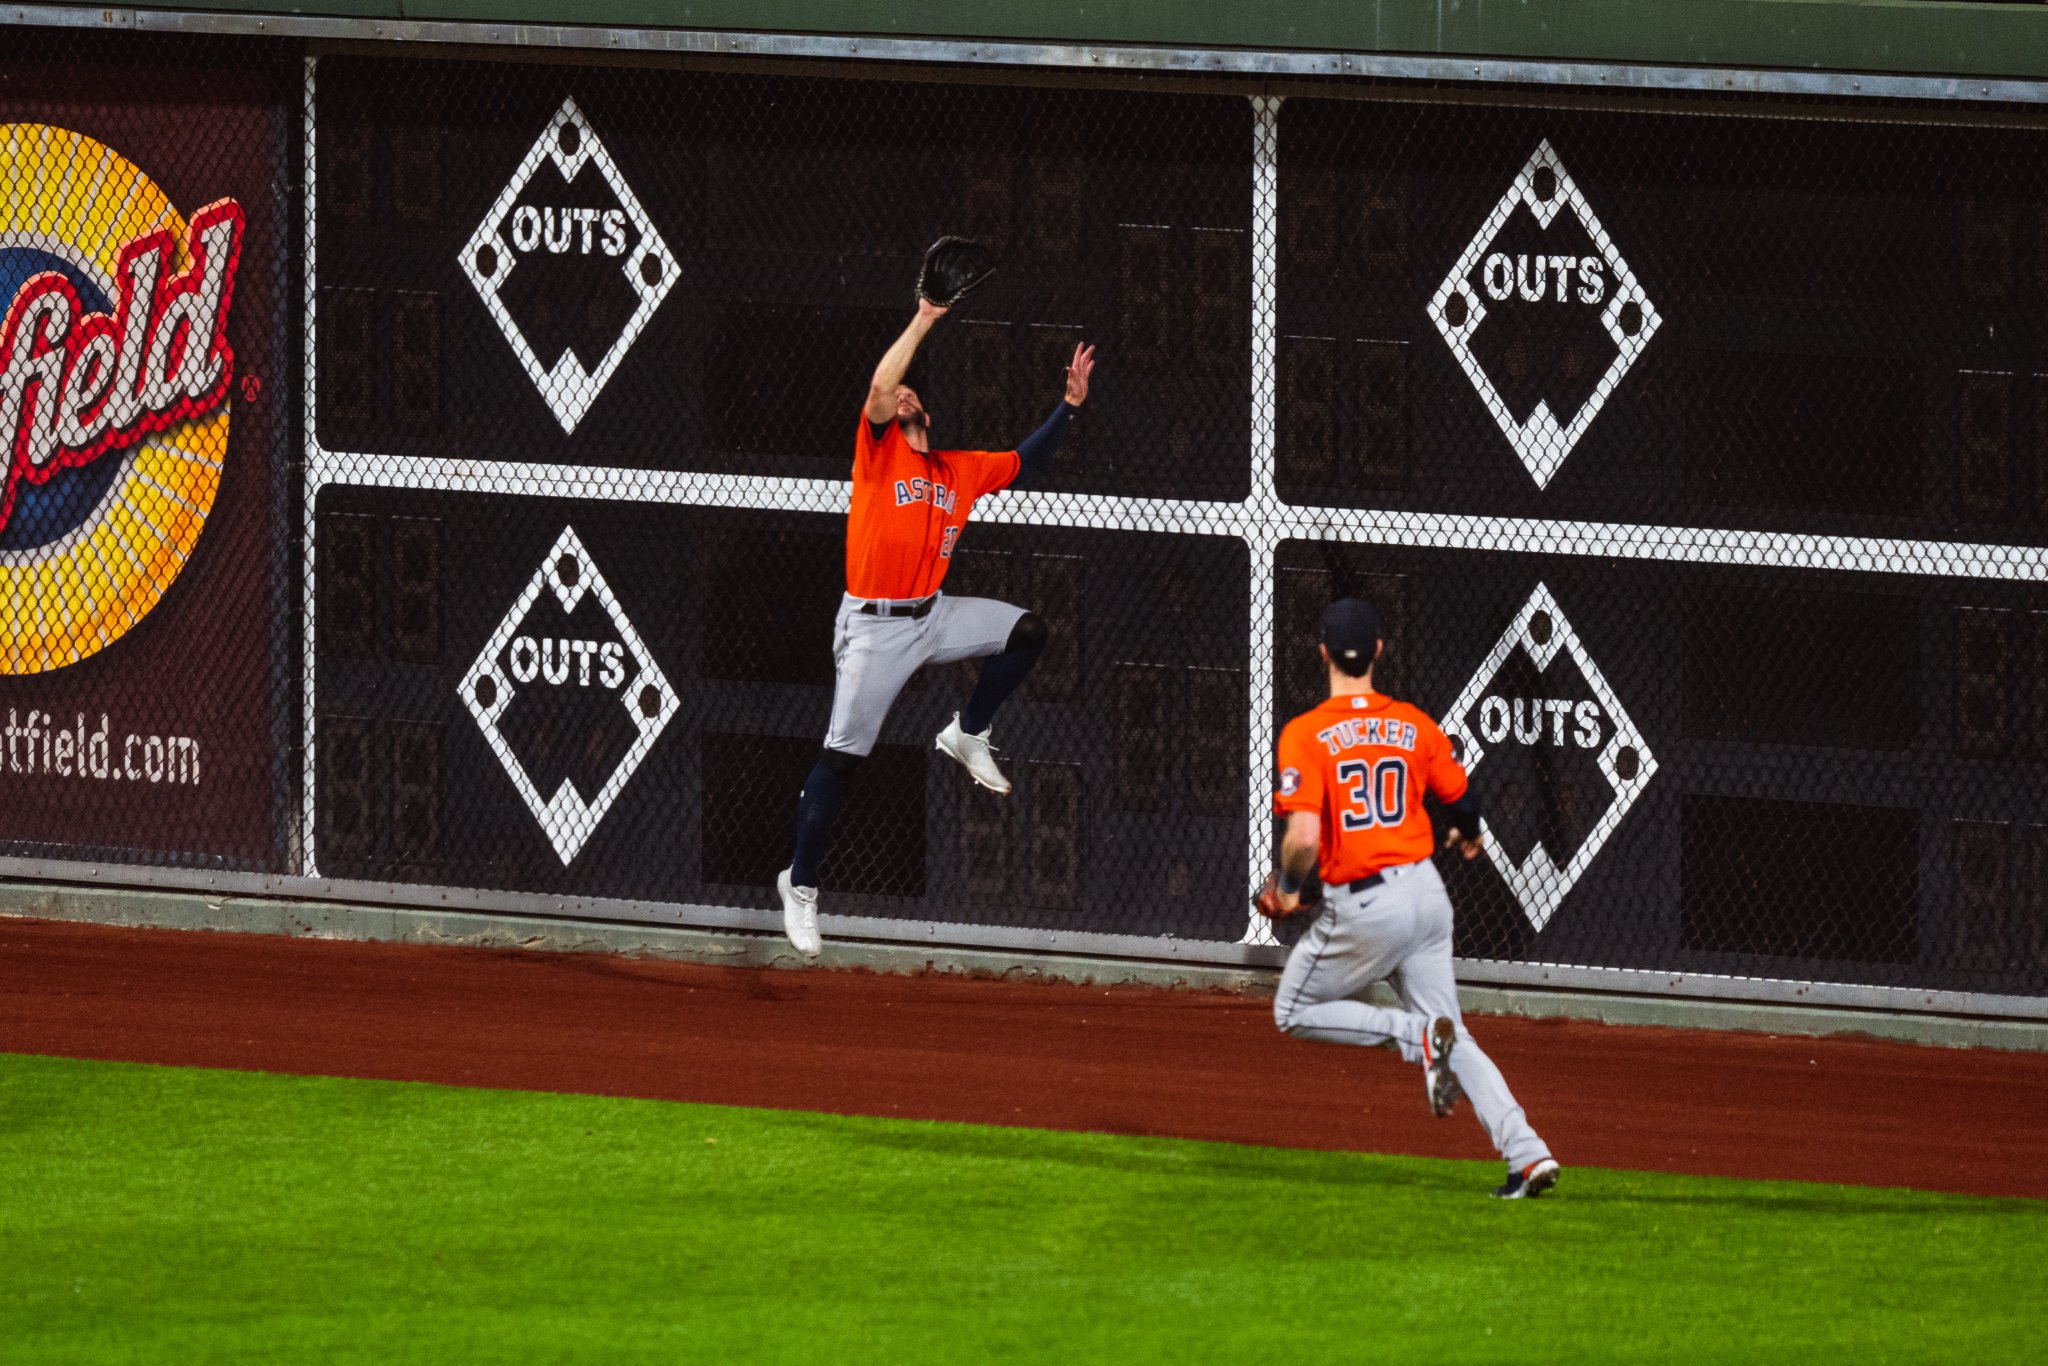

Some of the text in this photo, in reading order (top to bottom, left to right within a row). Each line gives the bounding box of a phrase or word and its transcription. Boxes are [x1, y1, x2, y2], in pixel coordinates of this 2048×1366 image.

[512, 205, 627, 256] OUTS
[1483, 252, 1605, 304] OUTS
[510, 635, 625, 689] OUTS
[0, 707, 200, 785] tfield.com
[1317, 717, 1418, 756] TUCKER
[1480, 695, 1601, 749] OUTS
[1337, 756, 1408, 832] 30
